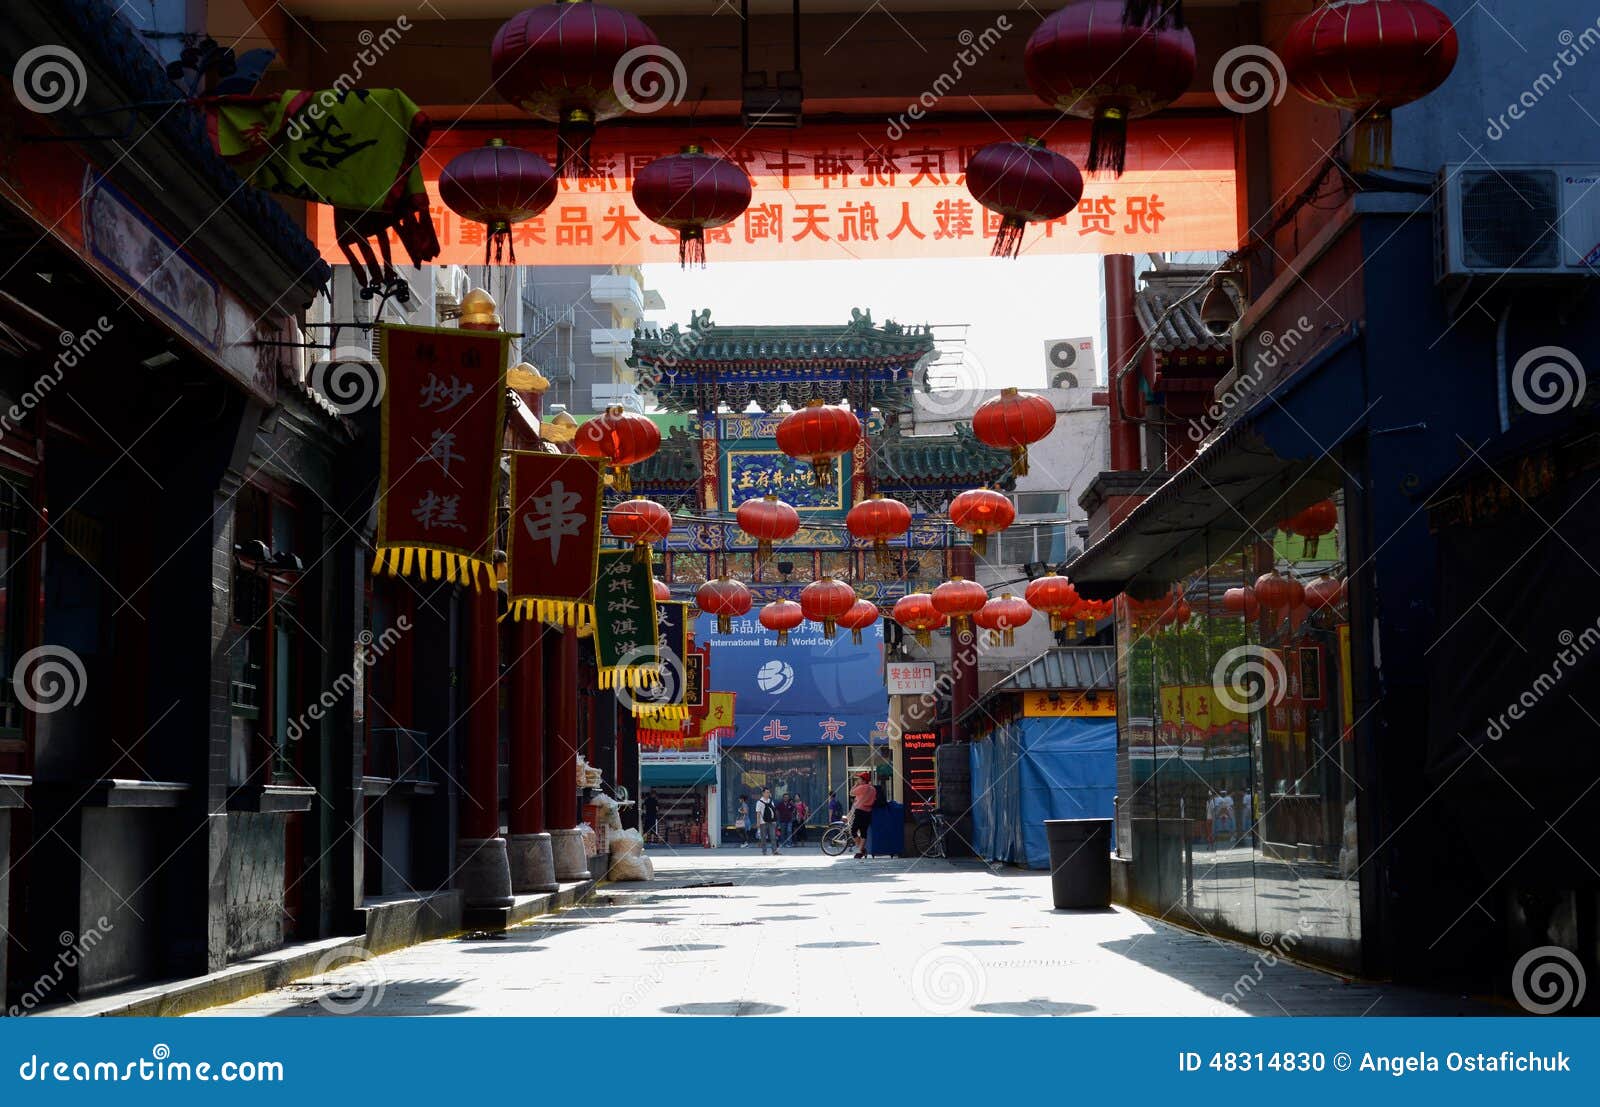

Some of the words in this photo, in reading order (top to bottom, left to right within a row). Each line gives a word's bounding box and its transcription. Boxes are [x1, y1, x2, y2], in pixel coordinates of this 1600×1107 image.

[411, 372, 474, 534] 炒年糕
[522, 480, 587, 567] 串
[710, 637, 760, 647] International
[791, 637, 816, 646] World
[817, 637, 834, 648] City
[890, 667, 932, 681] 安全出口
[897, 680, 926, 689] EXIT
